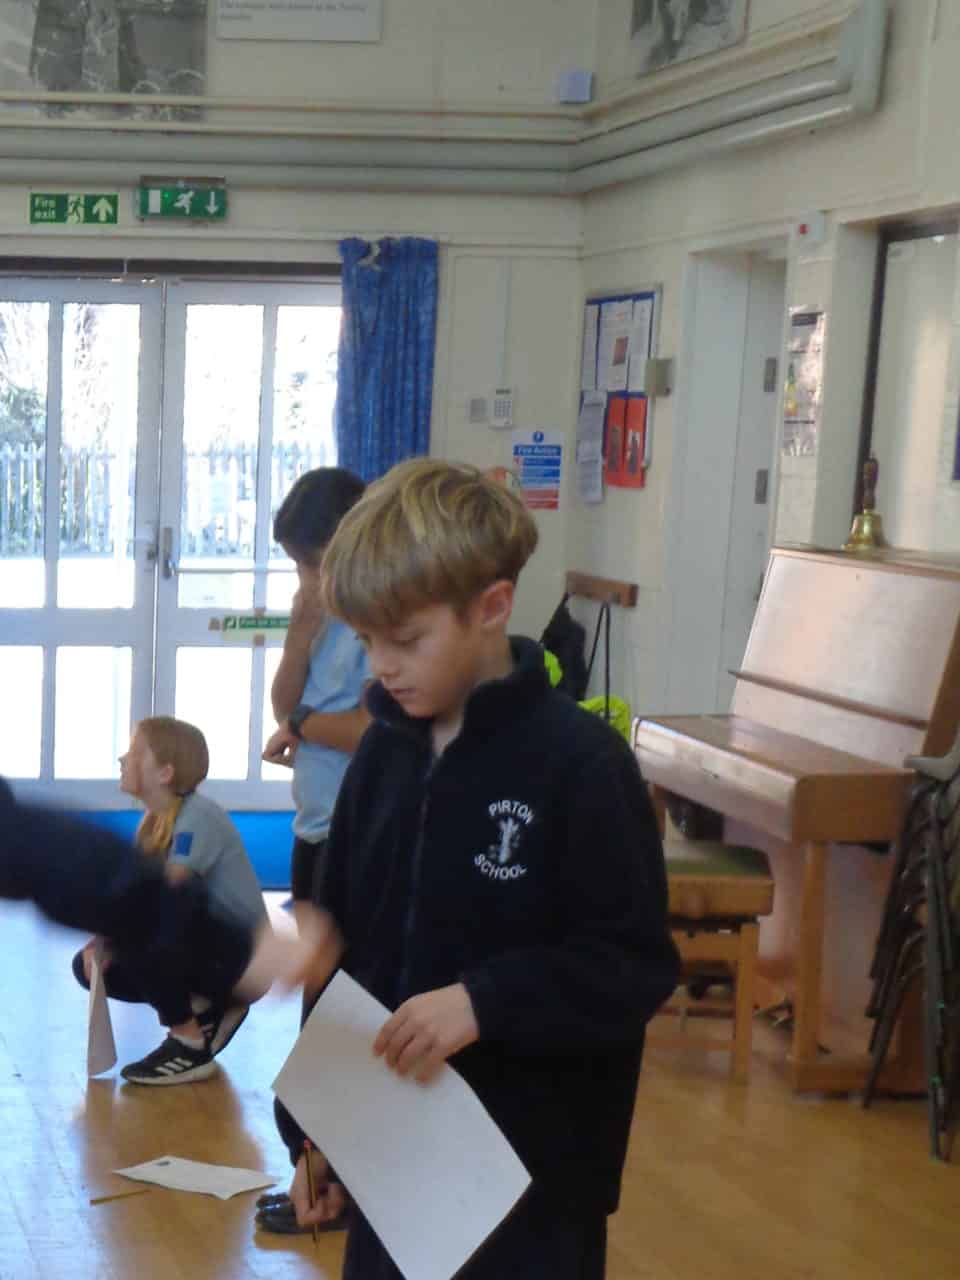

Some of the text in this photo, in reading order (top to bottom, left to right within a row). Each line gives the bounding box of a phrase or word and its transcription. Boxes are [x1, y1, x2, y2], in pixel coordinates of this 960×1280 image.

[34, 196, 56, 208] Fire
[34, 208, 56, 219] exit
[488, 799, 535, 825] PIRTON
[474, 853, 527, 880] SCHOOL
